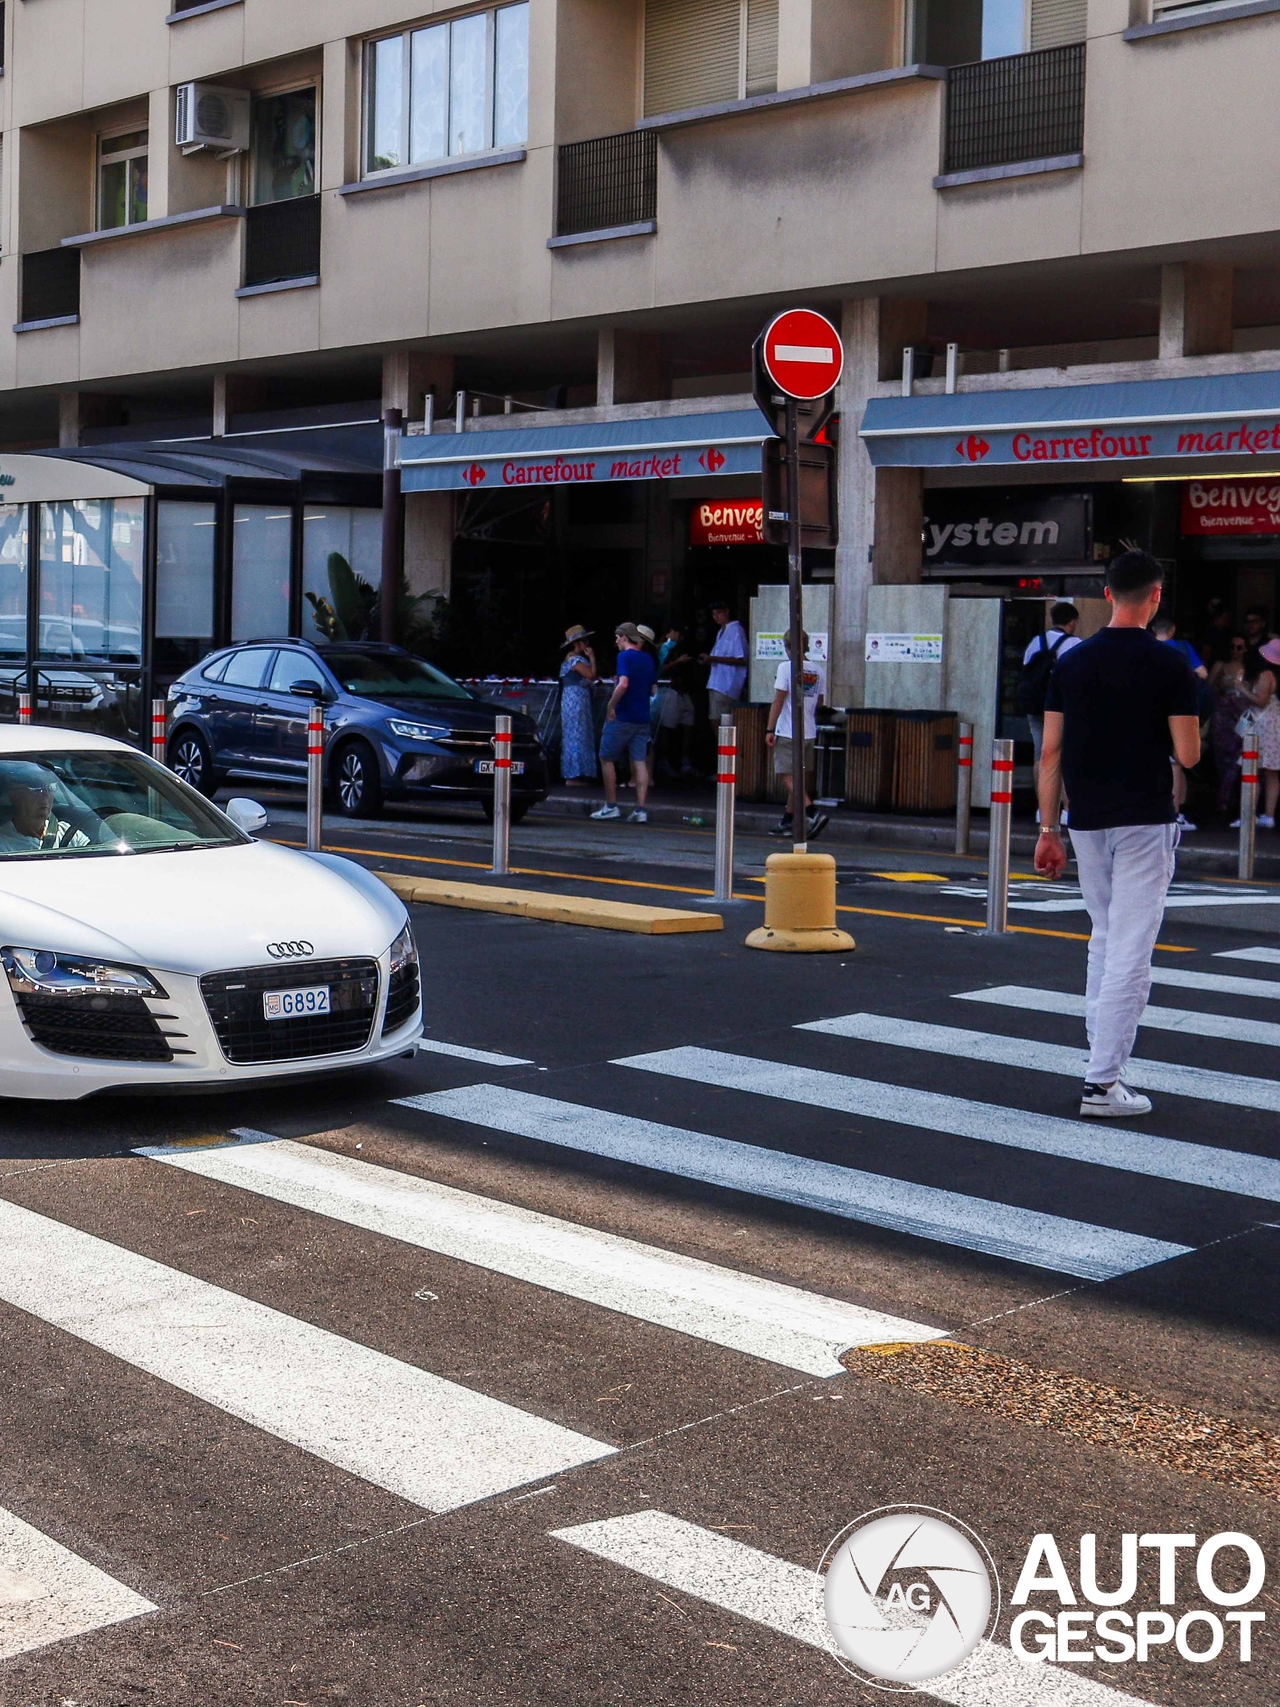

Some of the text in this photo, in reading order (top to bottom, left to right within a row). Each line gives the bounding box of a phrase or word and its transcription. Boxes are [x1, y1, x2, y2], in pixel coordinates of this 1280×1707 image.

[1012, 423, 1280, 461] Carrefour market
[502, 453, 682, 485] Carrefour market
[923, 516, 1059, 555] ystem
[1200, 516, 1254, 528] Bienvenue
[708, 532, 745, 542] Bienvenue
[283, 991, 327, 1013] G892
